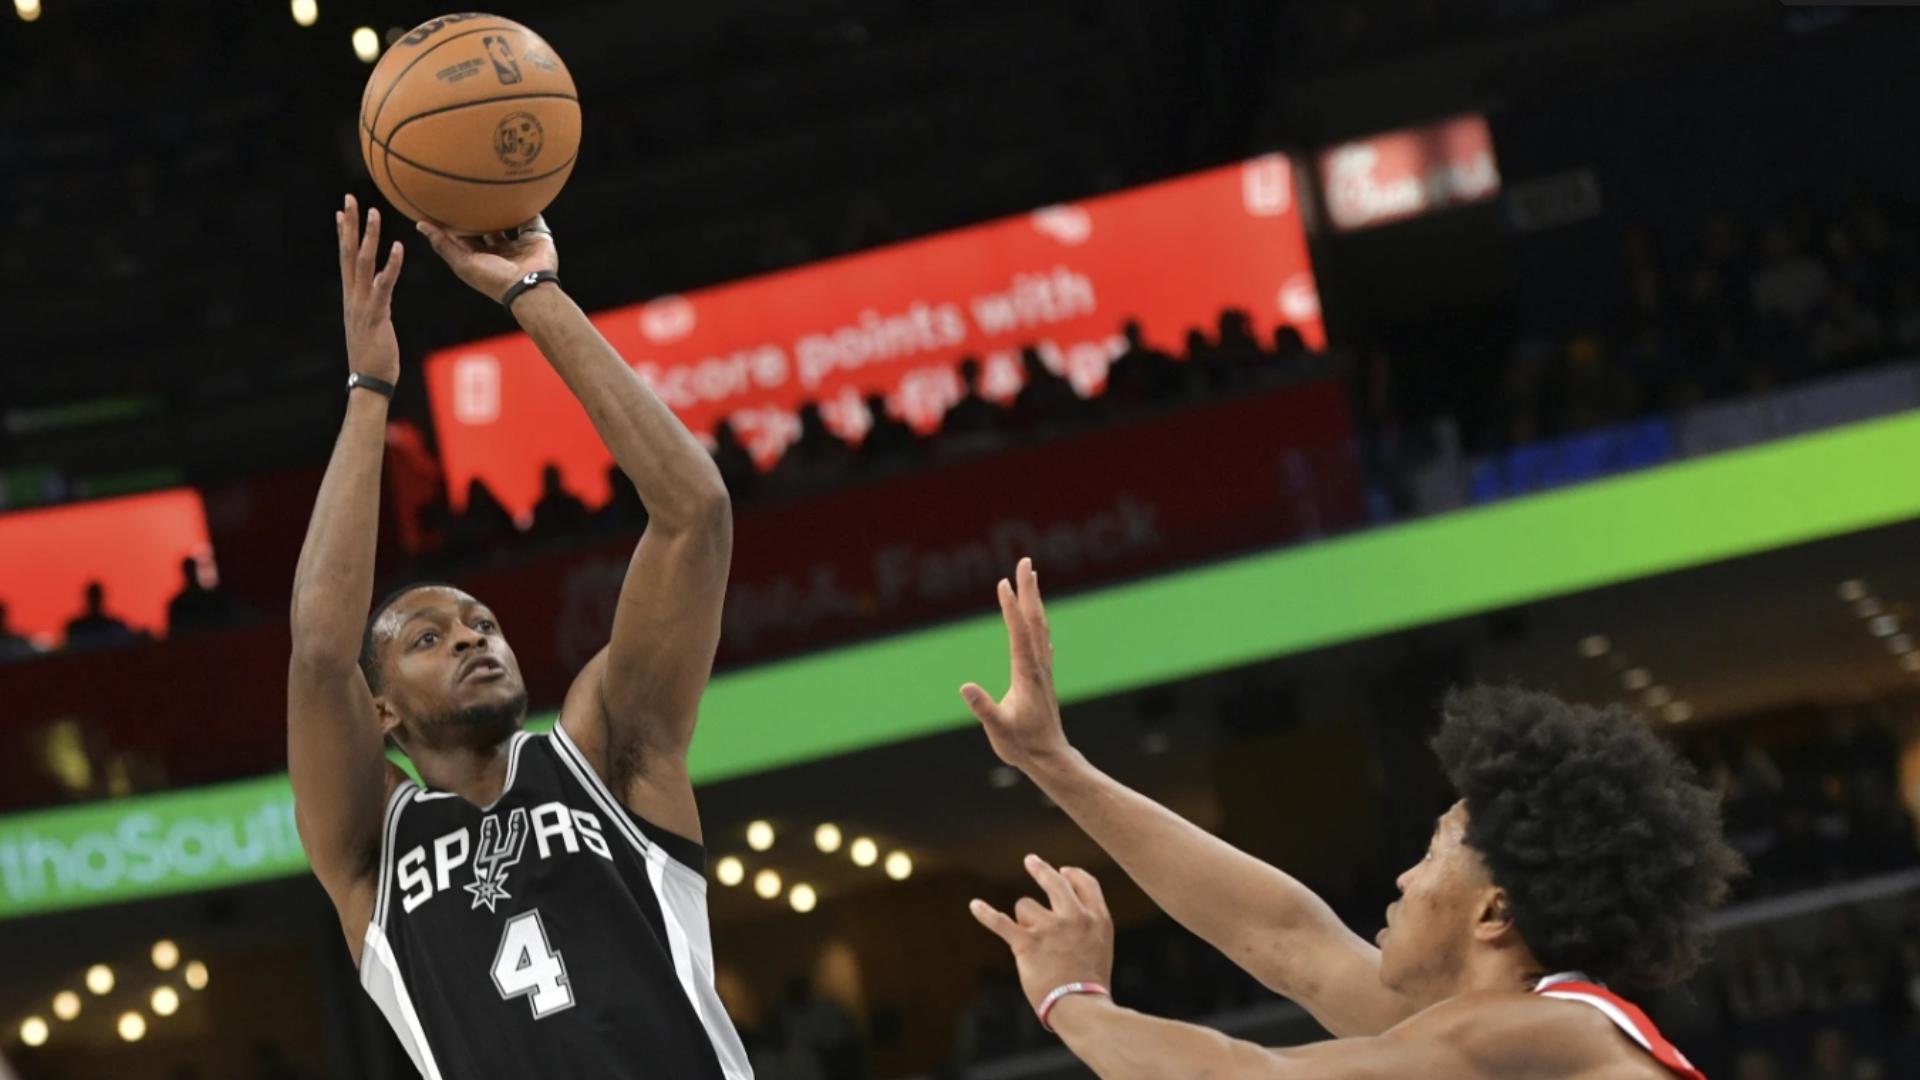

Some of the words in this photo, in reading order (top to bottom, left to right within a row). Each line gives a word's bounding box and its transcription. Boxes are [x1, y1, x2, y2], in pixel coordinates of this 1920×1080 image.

[795, 300, 966, 390] points
[971, 265, 1097, 335] with
[397, 802, 613, 914] SPURS
[490, 908, 576, 1020] 4
